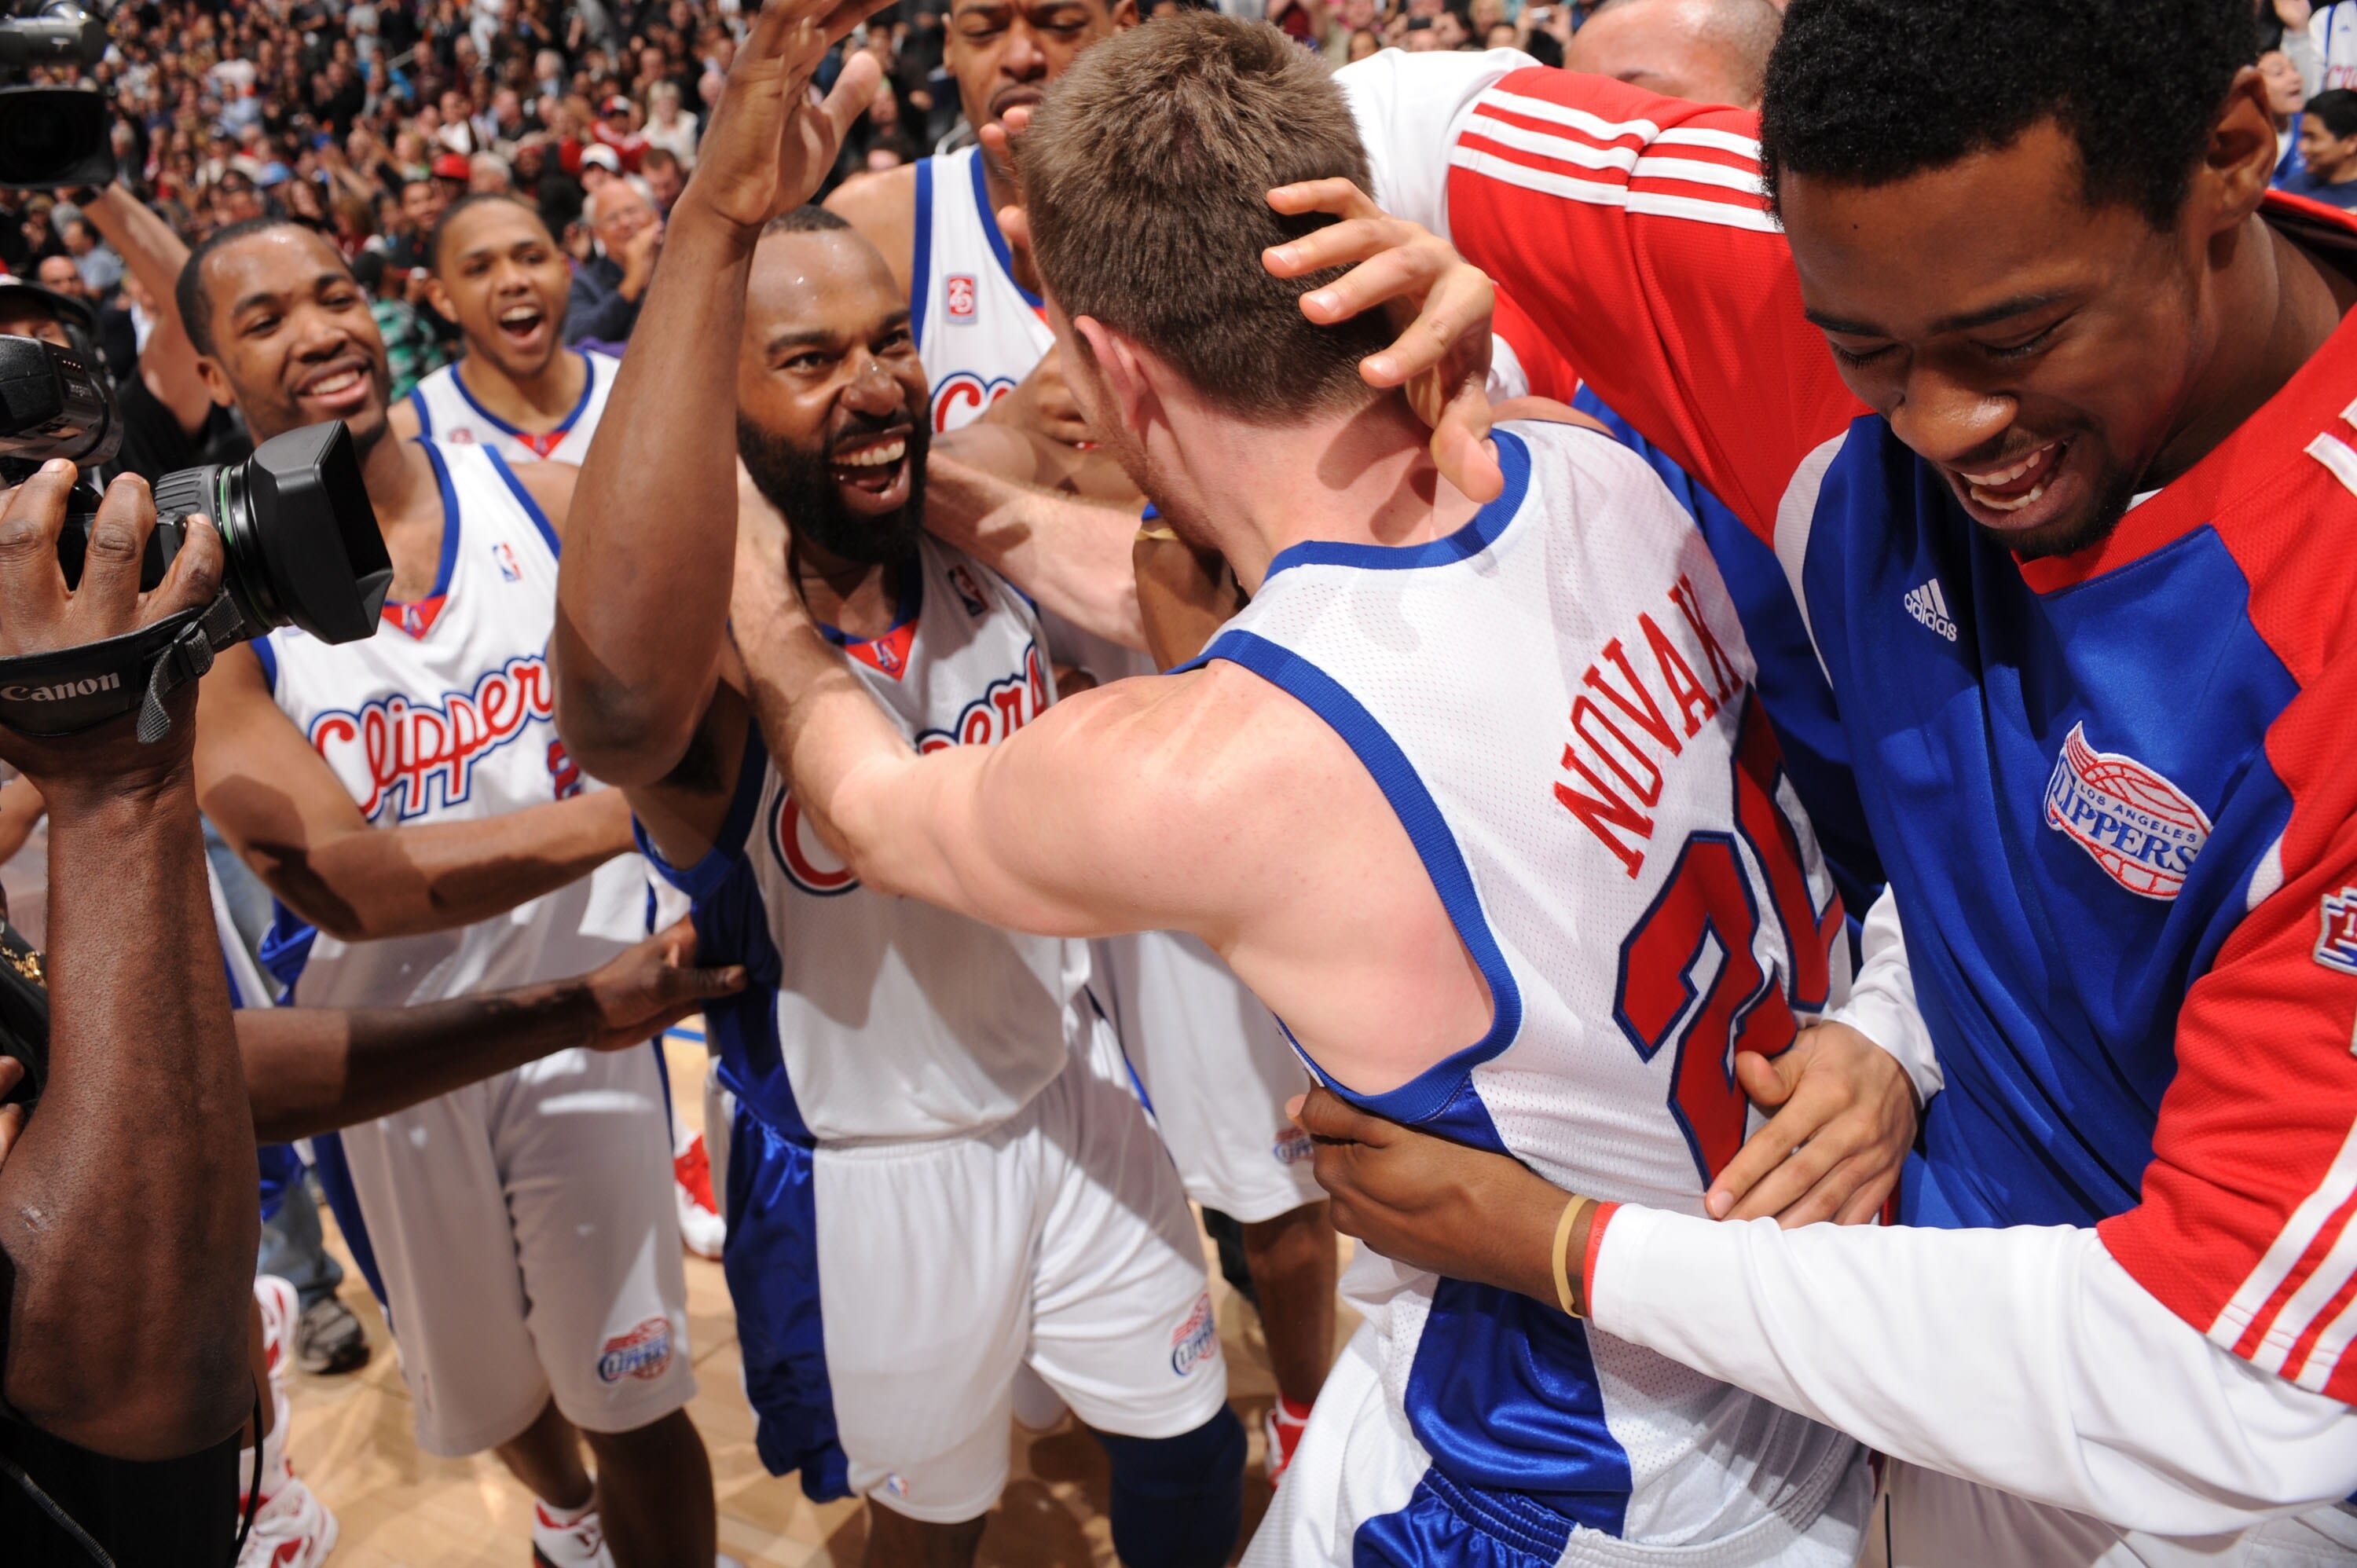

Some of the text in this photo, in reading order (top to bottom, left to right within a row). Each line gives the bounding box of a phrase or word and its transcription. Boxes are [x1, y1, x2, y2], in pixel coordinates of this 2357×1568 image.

[1904, 592, 1957, 642] adidas
[0, 672, 120, 702] Canon
[308, 654, 553, 822] Clipper
[1552, 573, 1743, 880] NOVAK
[2080, 783, 2198, 844] LOS ANGELES
